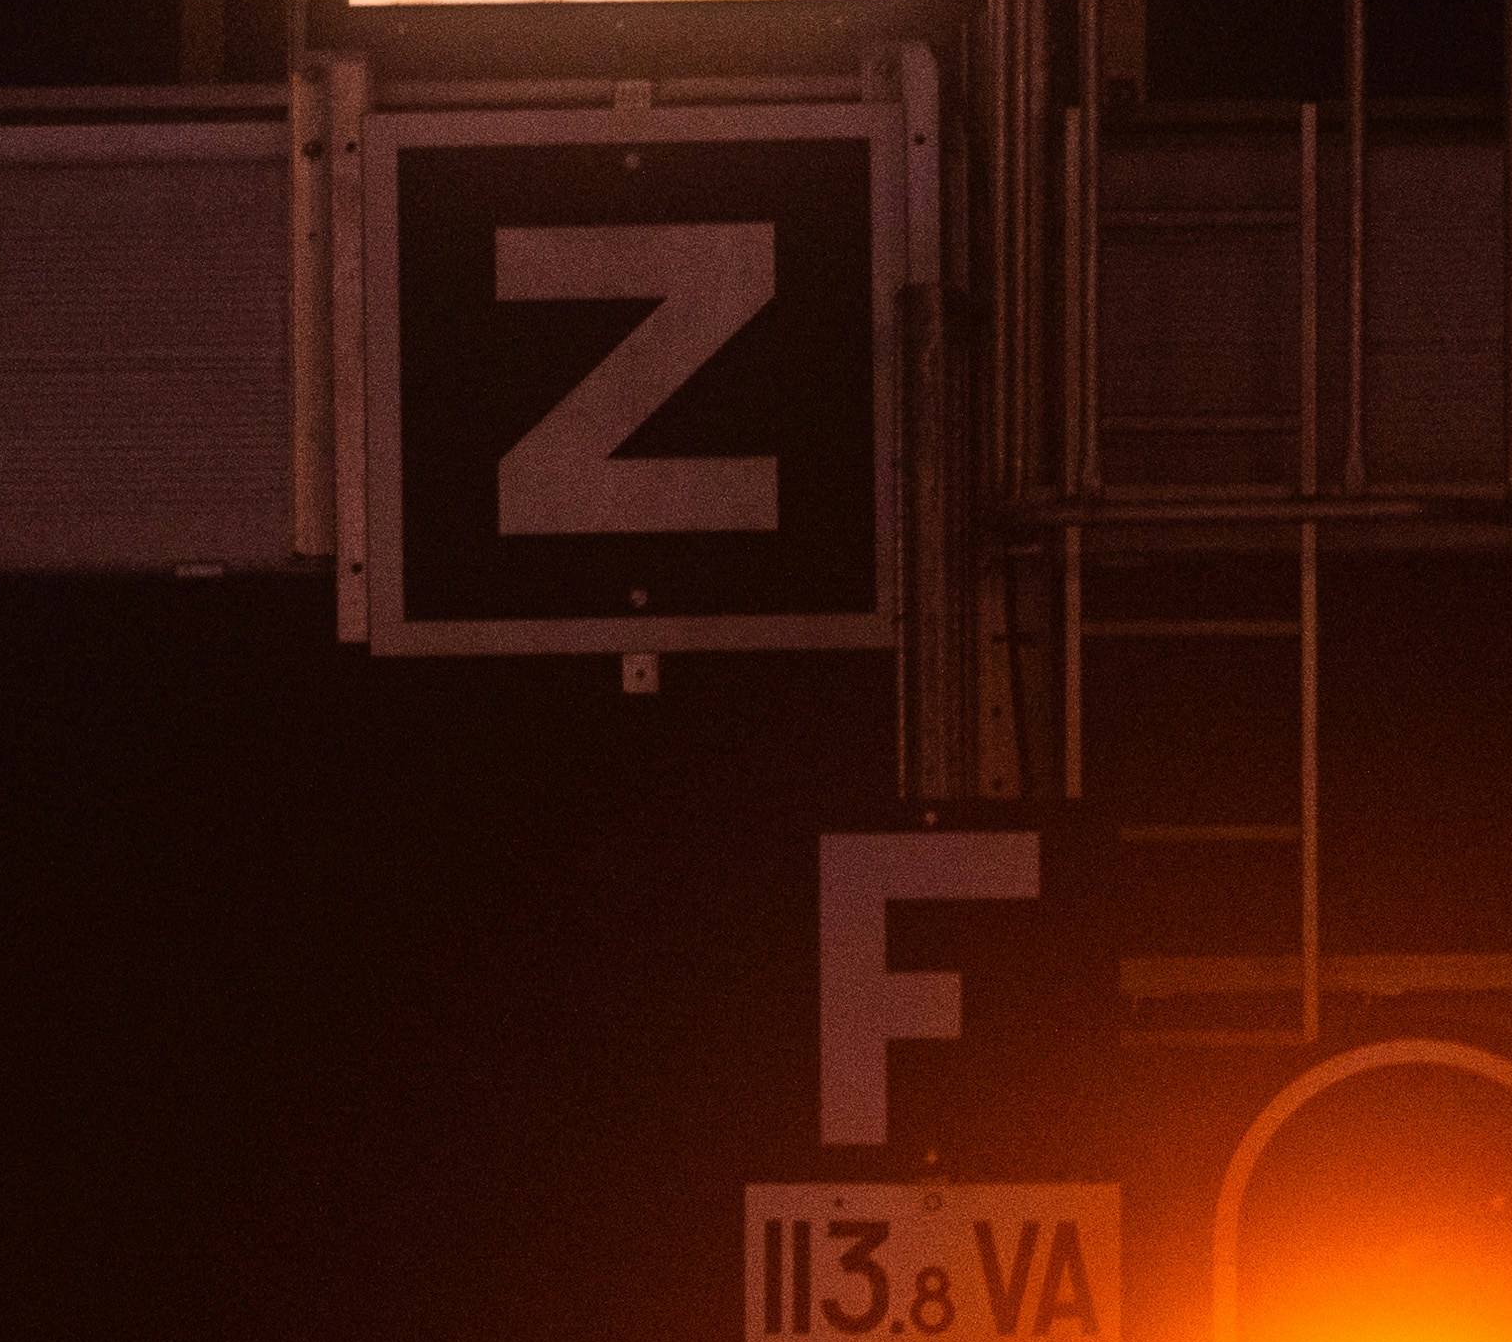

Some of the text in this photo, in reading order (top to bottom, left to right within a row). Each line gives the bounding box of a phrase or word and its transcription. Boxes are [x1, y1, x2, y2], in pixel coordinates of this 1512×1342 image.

[495, 222, 779, 535] Z
[820, 831, 1040, 1145] F
[763, 1220, 1096, 1336] 113.8 VA
